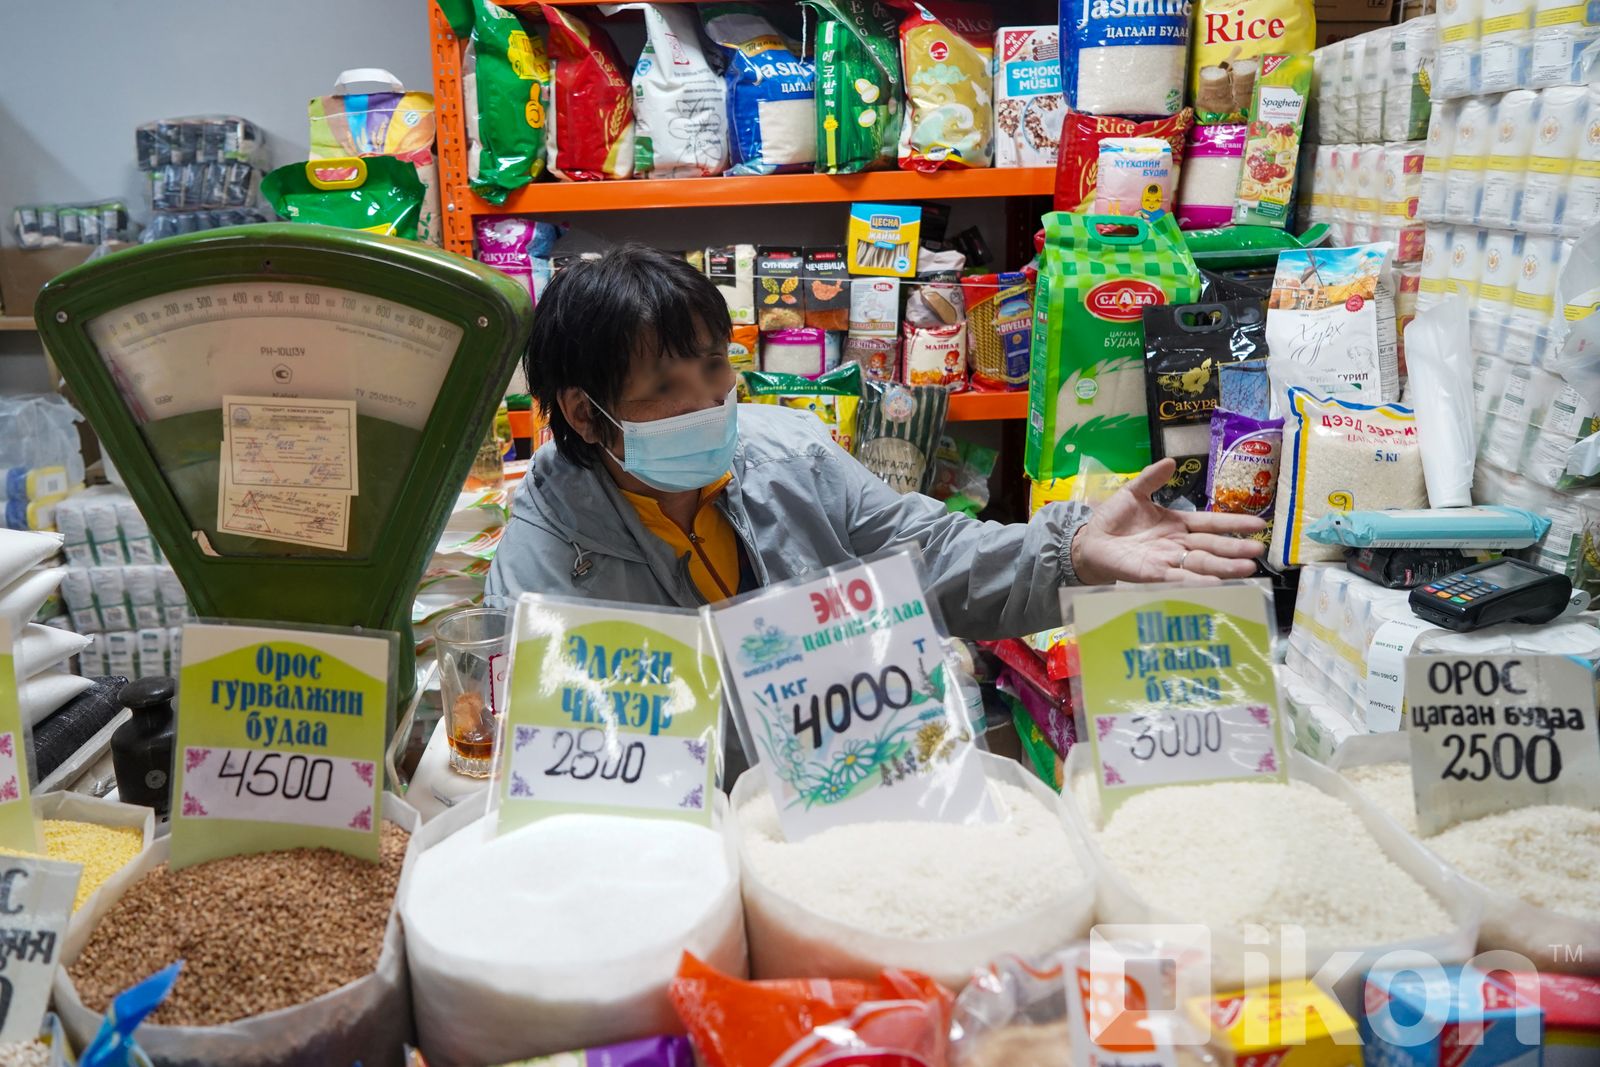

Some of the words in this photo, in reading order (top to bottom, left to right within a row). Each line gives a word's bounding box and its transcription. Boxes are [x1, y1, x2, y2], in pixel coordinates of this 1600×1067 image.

[1106, 25, 1156, 38] ЦАГААН
[1204, 9, 1285, 45] Rice
[1019, 76, 1058, 90] MÜSLI
[1262, 97, 1301, 109] Spaghetti
[1096, 118, 1135, 134] Rice
[806, 262, 846, 271] ЧЕЧЕВИЦА
[232, 292, 248, 304] 400
[268, 291, 284, 303] 500
[305, 293, 320, 305] 600
[1001, 319, 1032, 333] DIVELLA
[925, 343, 959, 351] МАННАЯ
[1103, 337, 1141, 348] БУДАА
[1160, 399, 1217, 419] Сакура
[1322, 415, 1363, 433] ДЭЭД
[1234, 455, 1274, 464] ГЕРКУЛЕС
[1374, 450, 1383, 462] 5
[256, 645, 322, 681] Орос
[1427, 660, 1527, 697] ОРОС
[211, 680, 363, 716] гурвалжин
[793, 665, 912, 749] 4000
[1411, 702, 1495, 732] цагаан
[1504, 706, 1585, 735] будаа
[246, 712, 328, 747] будаа
[1131, 711, 1222, 760] 3000
[545, 727, 646, 783] 2800
[1442, 732, 1562, 783] 2500
[218, 750, 333, 800] 4500
